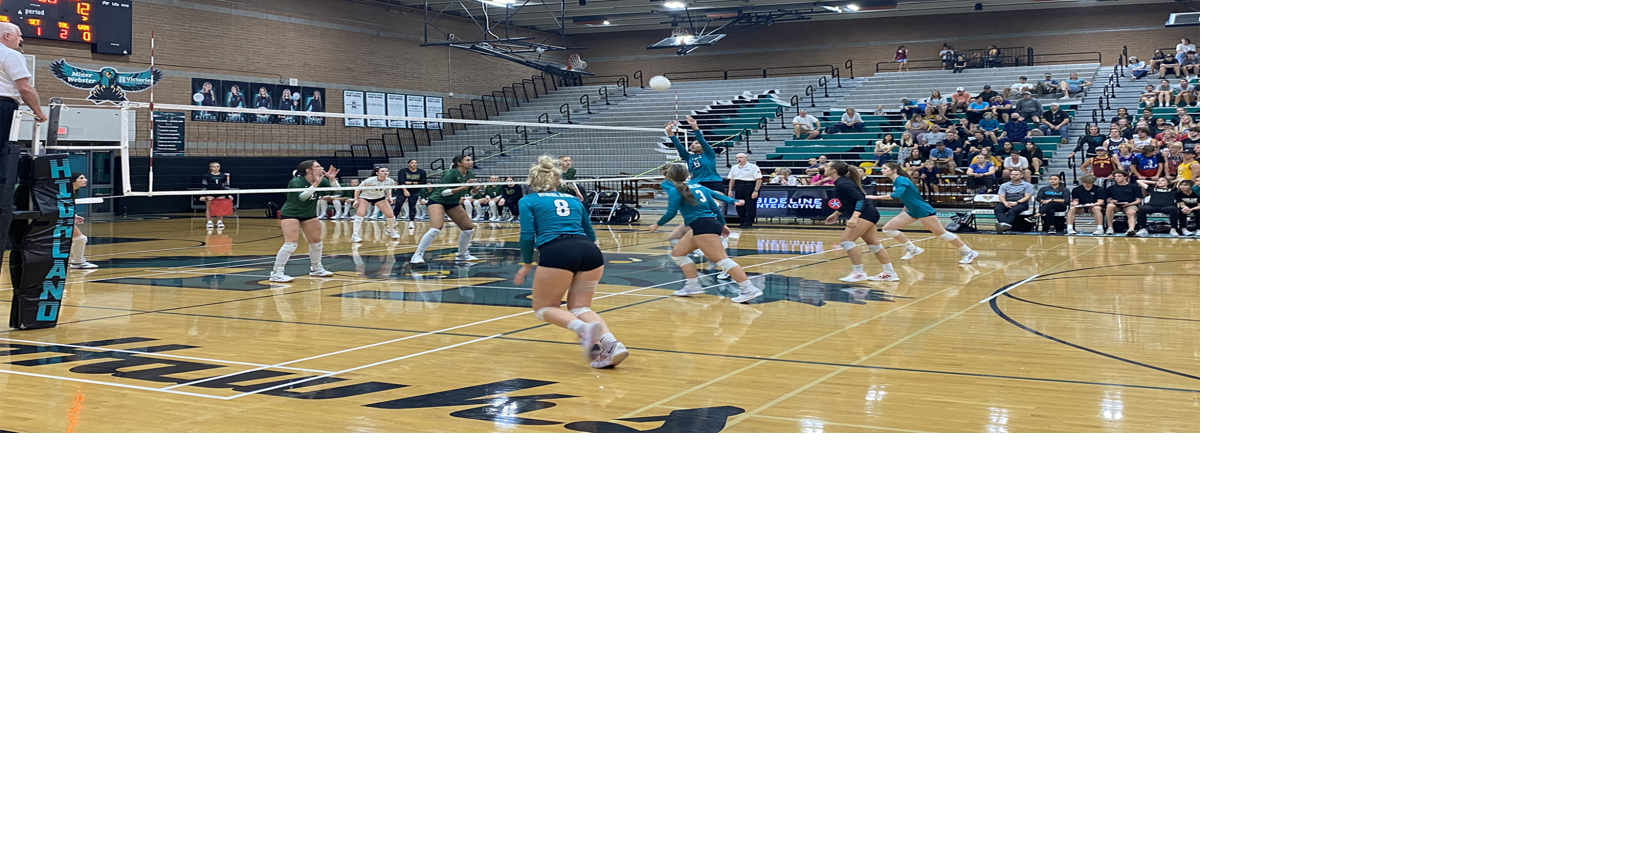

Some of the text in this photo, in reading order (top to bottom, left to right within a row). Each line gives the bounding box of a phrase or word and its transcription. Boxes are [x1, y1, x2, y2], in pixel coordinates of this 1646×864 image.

[76, 2, 91, 15] 12
[36, 27, 41, 36] 1
[59, 29, 68, 39] 2
[82, 31, 91, 41] 0
[694, 189, 707, 203] 3
[553, 199, 571, 217] 8
